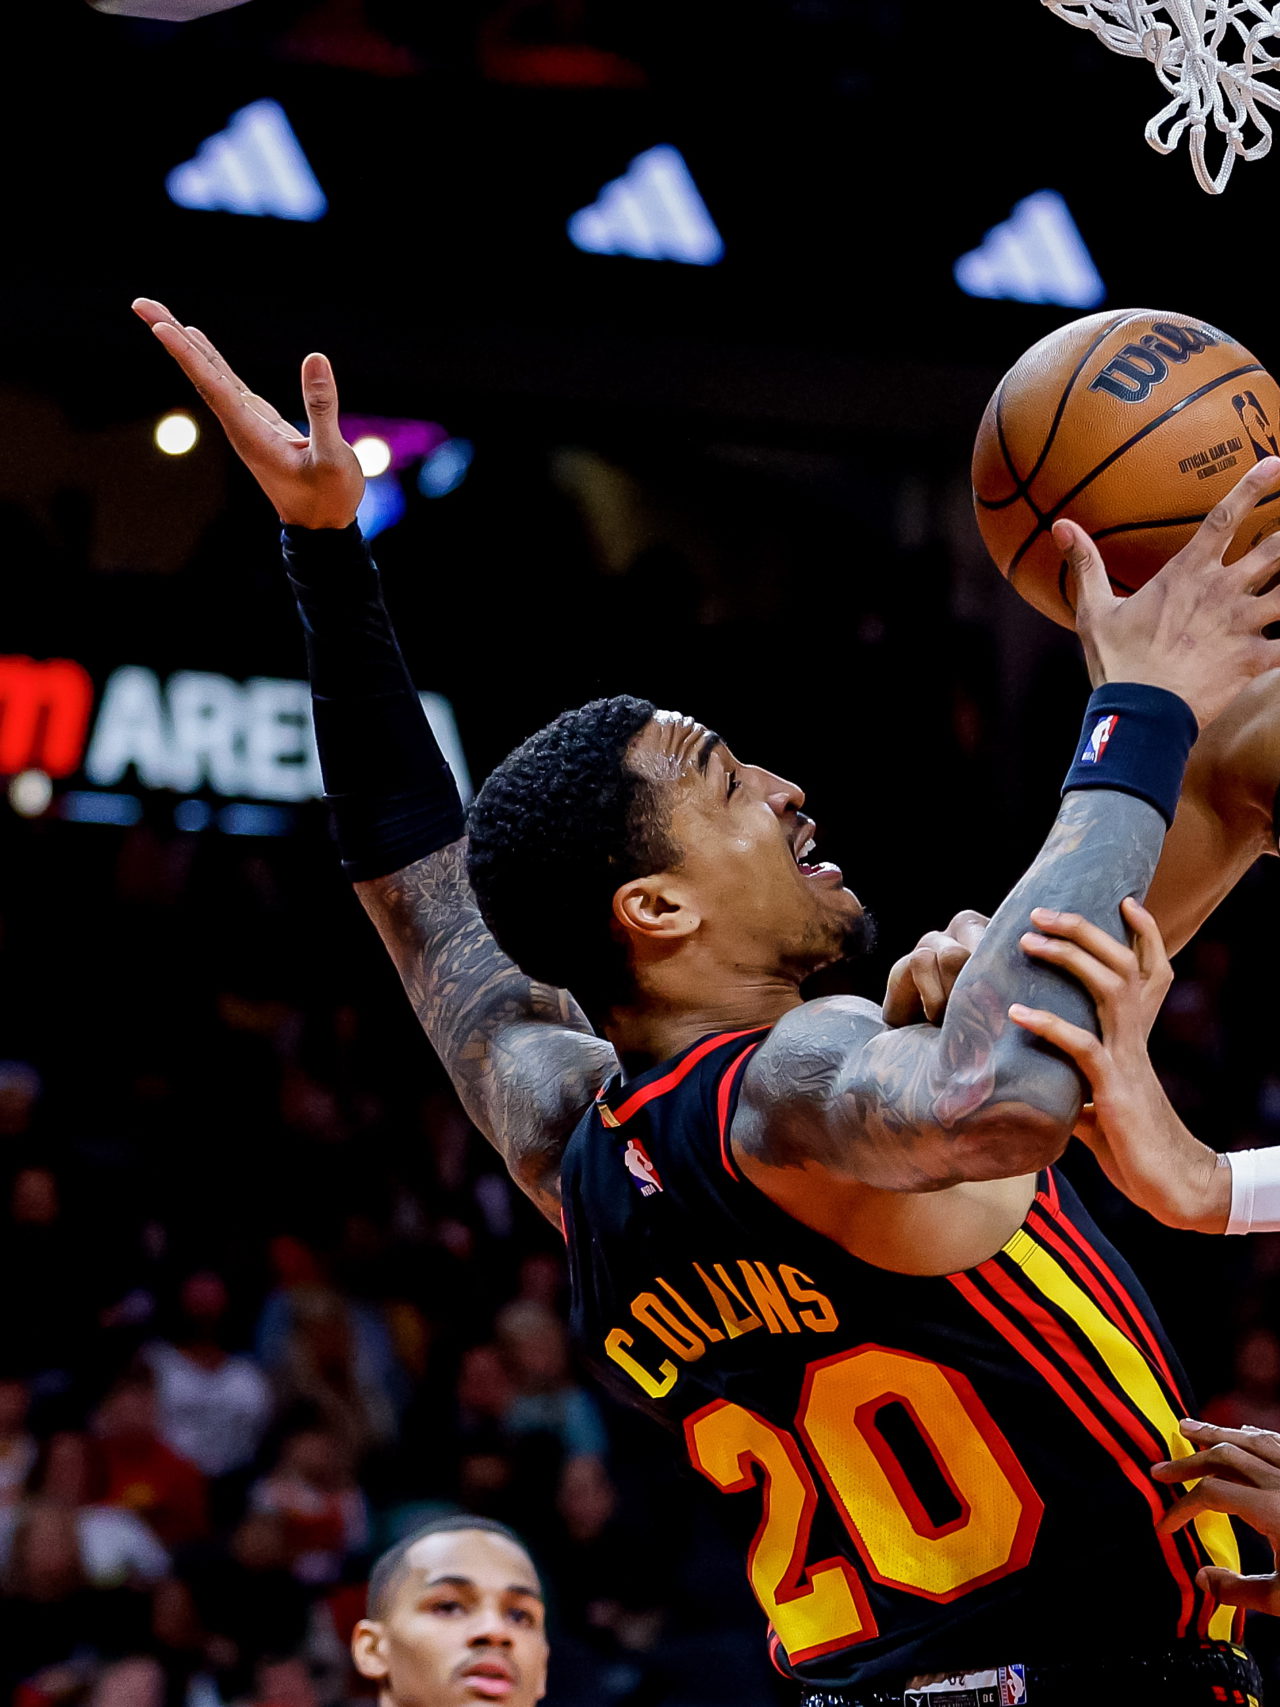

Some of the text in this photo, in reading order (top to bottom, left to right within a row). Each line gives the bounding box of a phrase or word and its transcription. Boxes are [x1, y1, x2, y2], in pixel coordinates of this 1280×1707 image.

[1087, 322, 1238, 405] Wils
[85, 664, 474, 803] ARE
[683, 1342, 1046, 1667] 20
